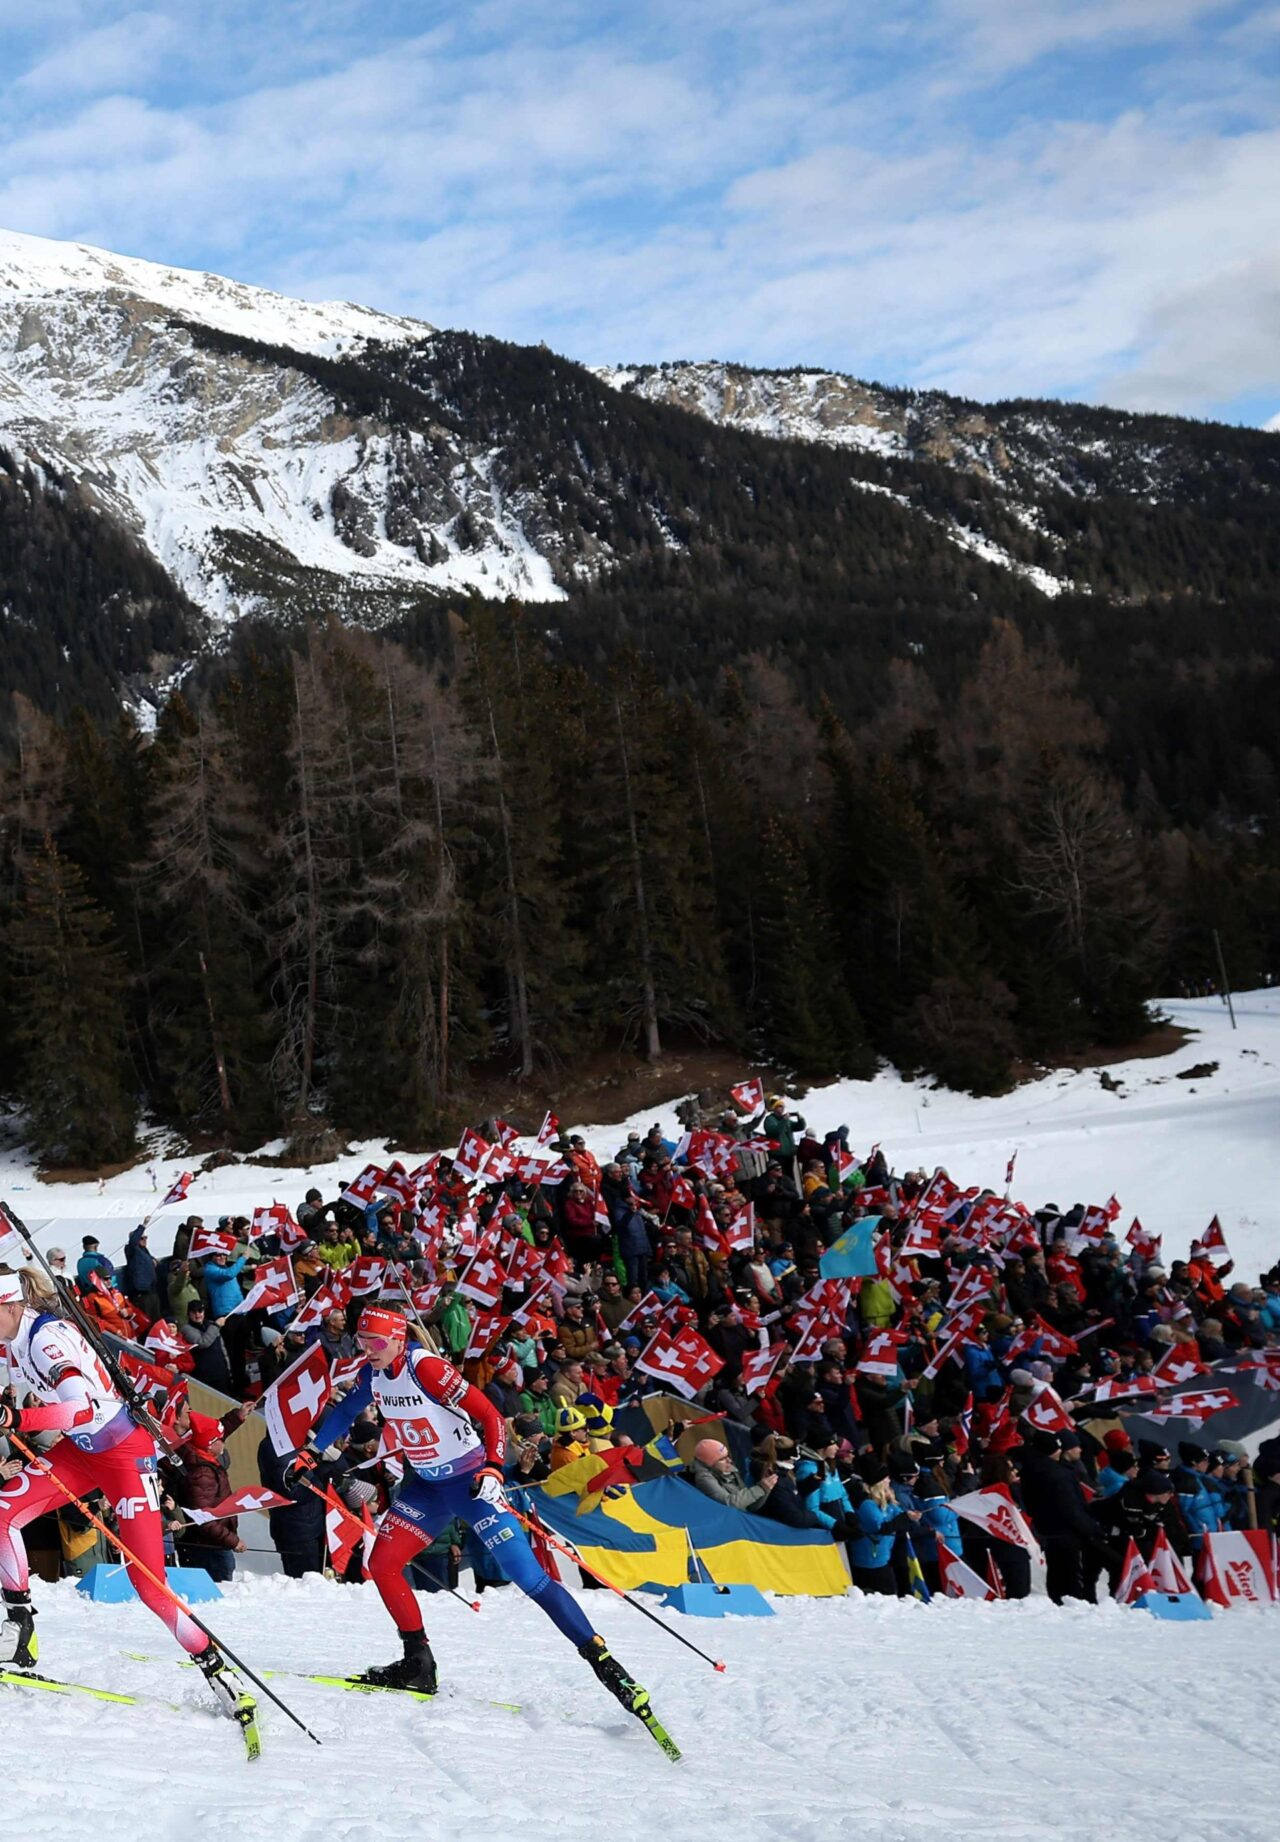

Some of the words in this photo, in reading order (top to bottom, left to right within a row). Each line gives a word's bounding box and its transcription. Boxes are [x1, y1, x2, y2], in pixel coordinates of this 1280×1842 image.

[382, 1394, 424, 1408] WÜRTH
[453, 1422, 472, 1441] 16
[115, 1496, 148, 1520] 4F
[1228, 1560, 1260, 1602] Stiegl
